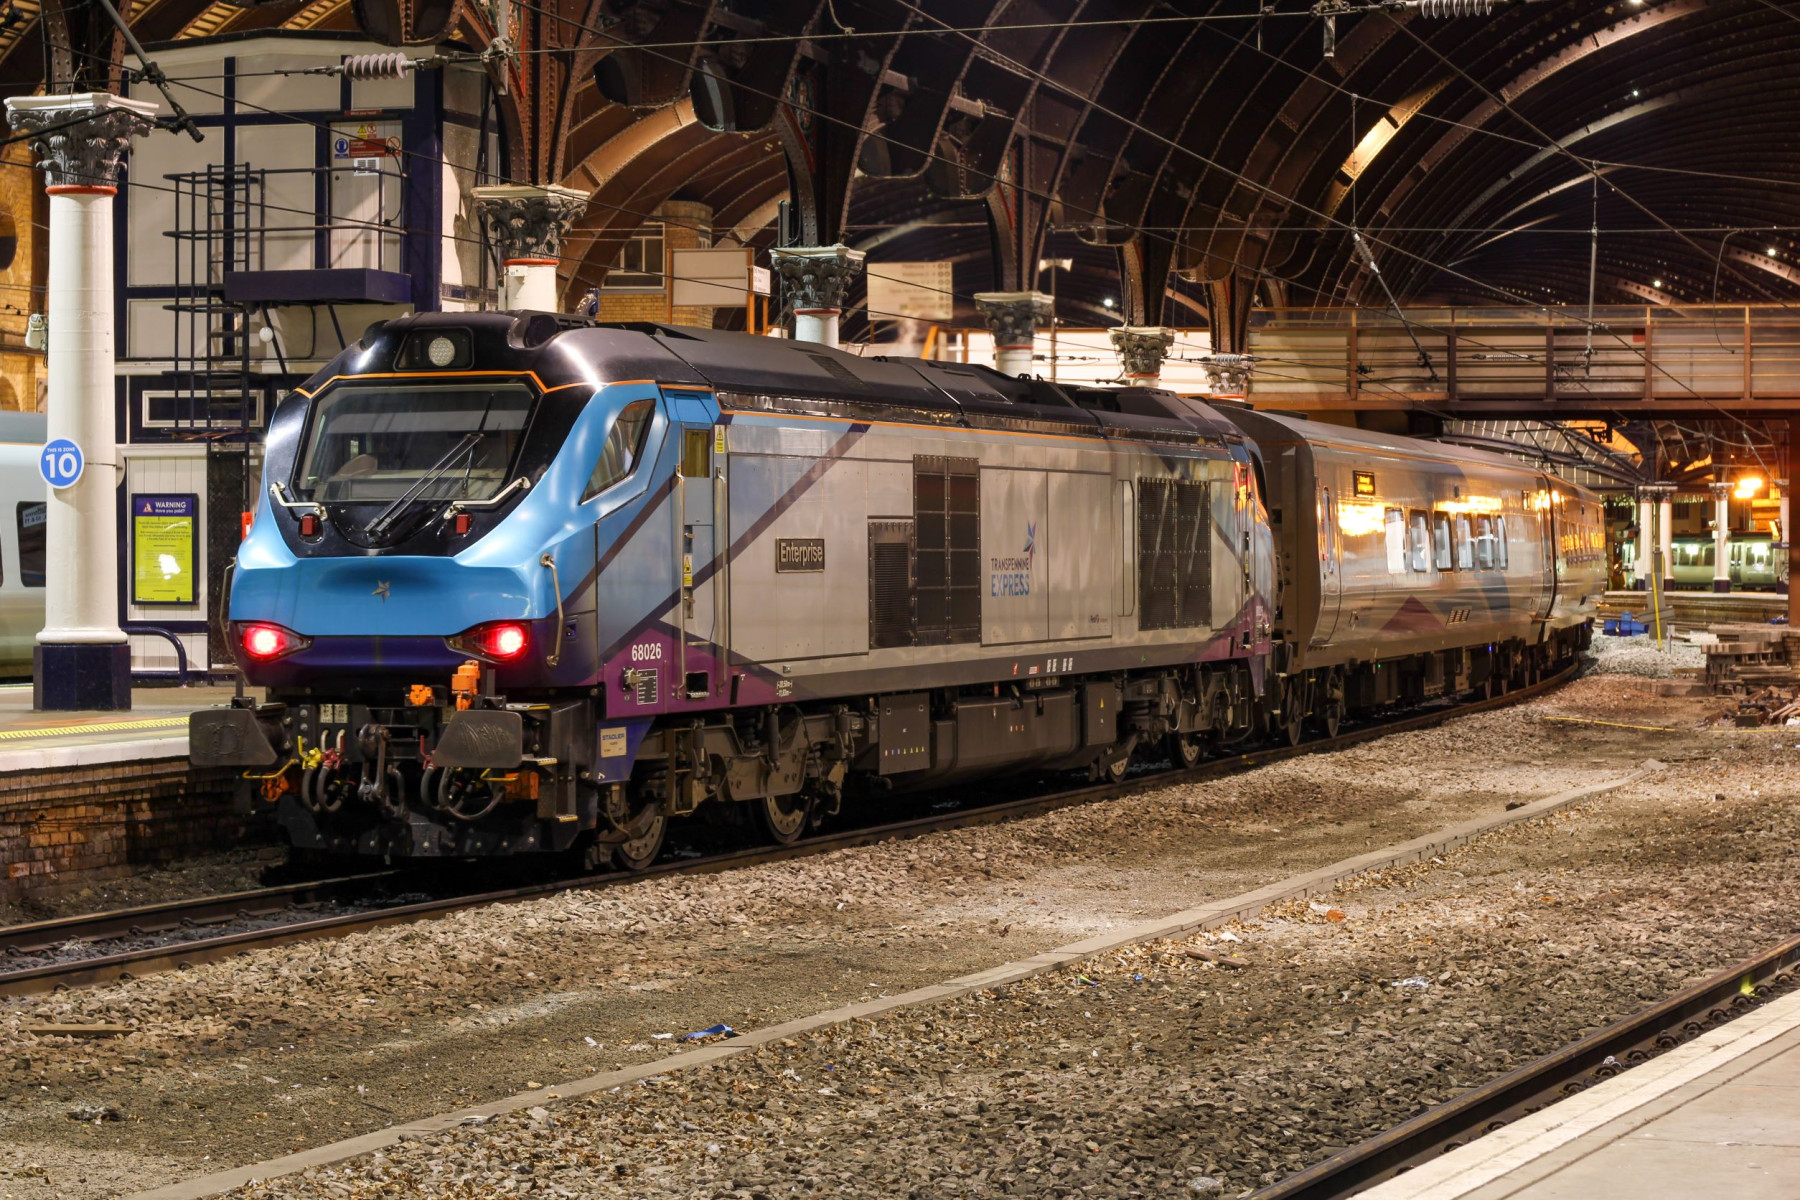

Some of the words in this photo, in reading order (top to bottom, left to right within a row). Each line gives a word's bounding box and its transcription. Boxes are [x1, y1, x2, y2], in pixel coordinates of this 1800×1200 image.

[45, 452, 78, 479] 10
[155, 501, 187, 509] WARNING
[780, 541, 823, 567] Enterprise
[991, 557, 1030, 571] TRANSPENNINE
[991, 573, 1030, 597] EXPRESS
[631, 642, 662, 661] 68026
